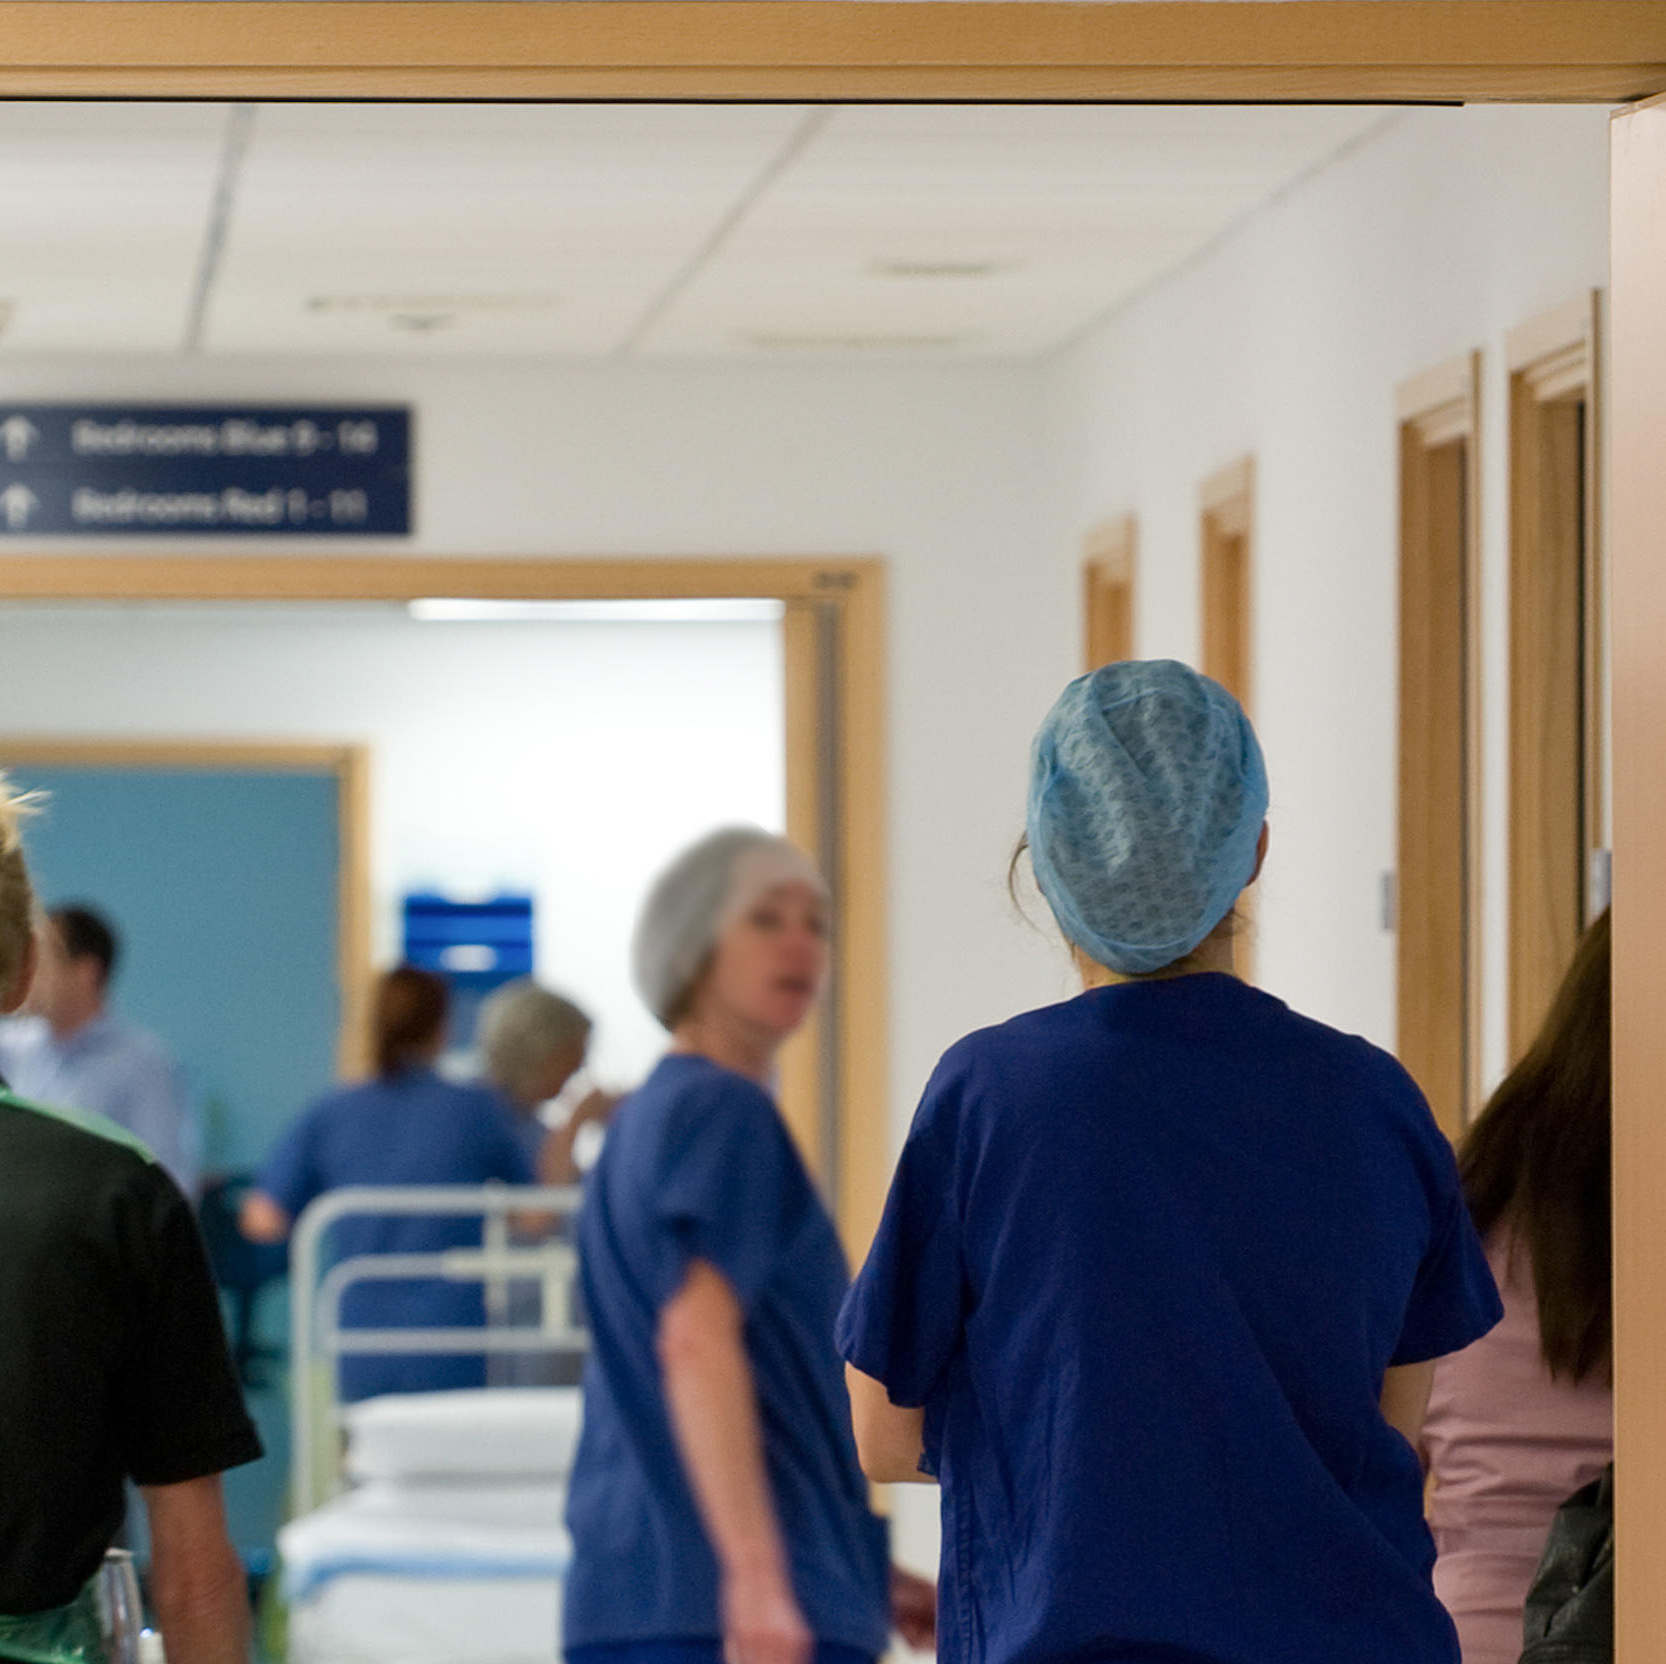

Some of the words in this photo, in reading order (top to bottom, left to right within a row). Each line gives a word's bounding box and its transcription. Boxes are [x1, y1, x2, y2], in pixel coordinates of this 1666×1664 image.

[72, 419, 216, 455] Bedrooms
[221, 419, 288, 455] Blue
[72, 488, 216, 523] Bedrooms
[221, 488, 283, 523] Red
